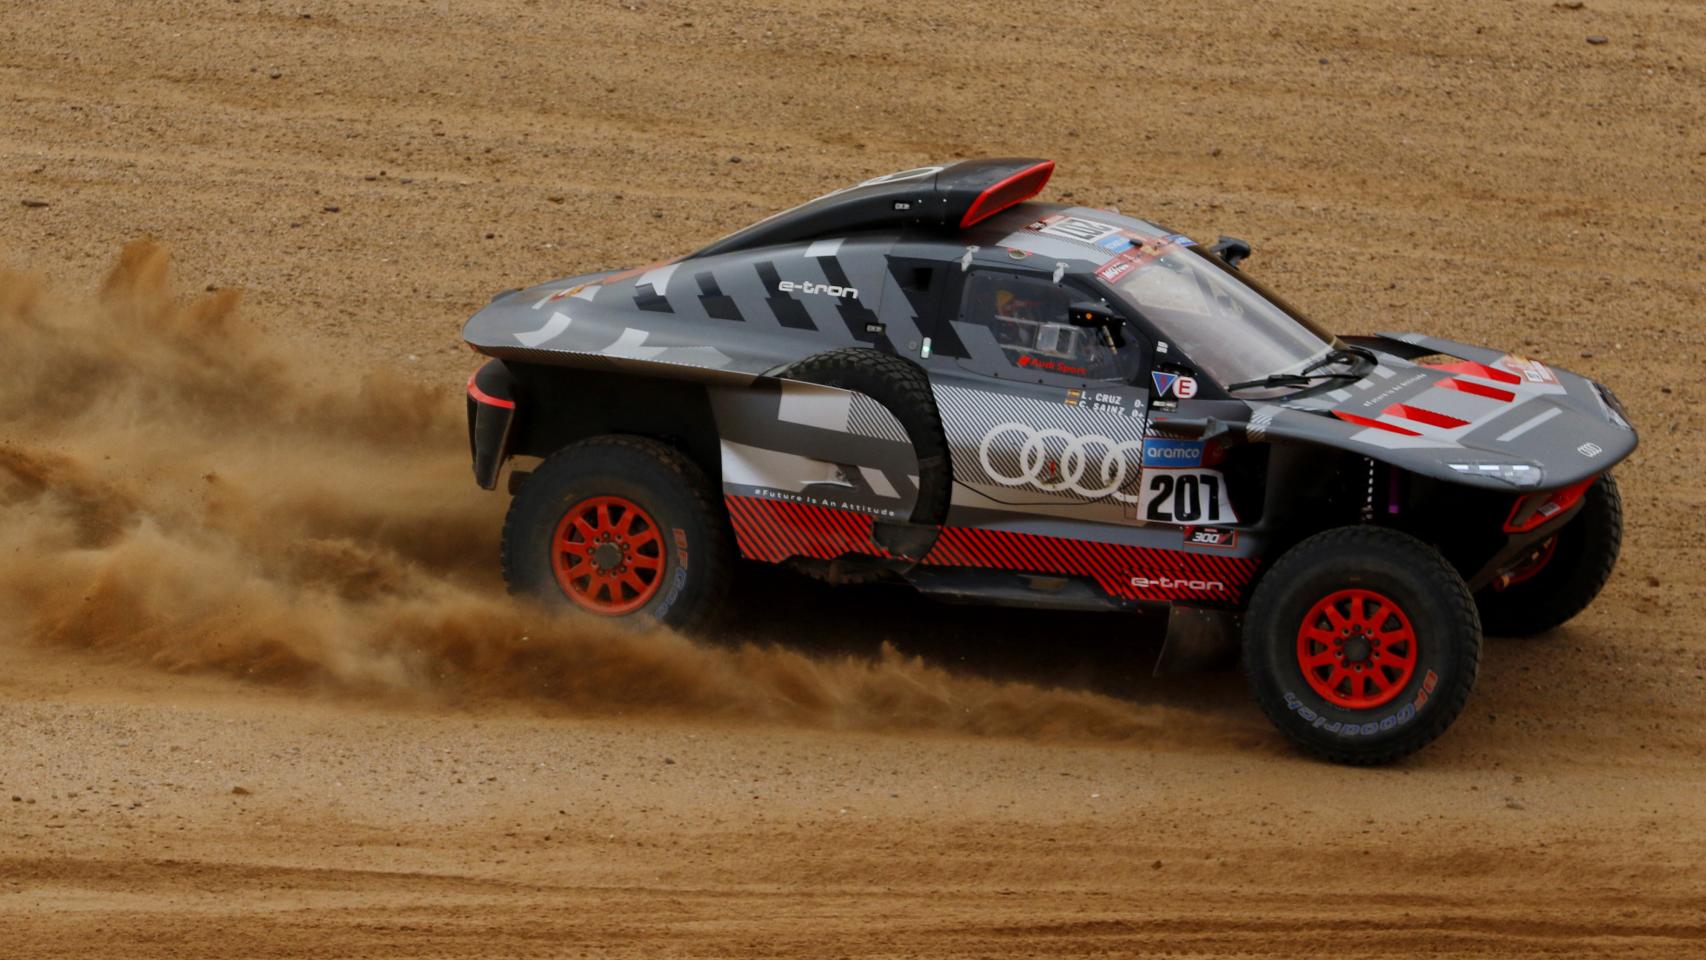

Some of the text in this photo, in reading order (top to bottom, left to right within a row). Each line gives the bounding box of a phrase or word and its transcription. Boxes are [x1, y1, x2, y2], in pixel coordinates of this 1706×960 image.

[778, 281, 859, 299] e-tron
[1030, 357, 1088, 375] Audi Sport
[1178, 379, 1192, 396] E
[1081, 390, 1092, 401] L.
[1095, 391, 1123, 406] CRUZ
[1078, 400, 1089, 410] C.
[1092, 401, 1126, 416] SAINZ
[1146, 447, 1201, 459] aramco
[754, 488, 895, 517] #Future Is An Attitude
[1146, 473, 1220, 522] 207
[1130, 576, 1225, 592] e-tron
[1283, 668, 1439, 736] BFGoodrich
